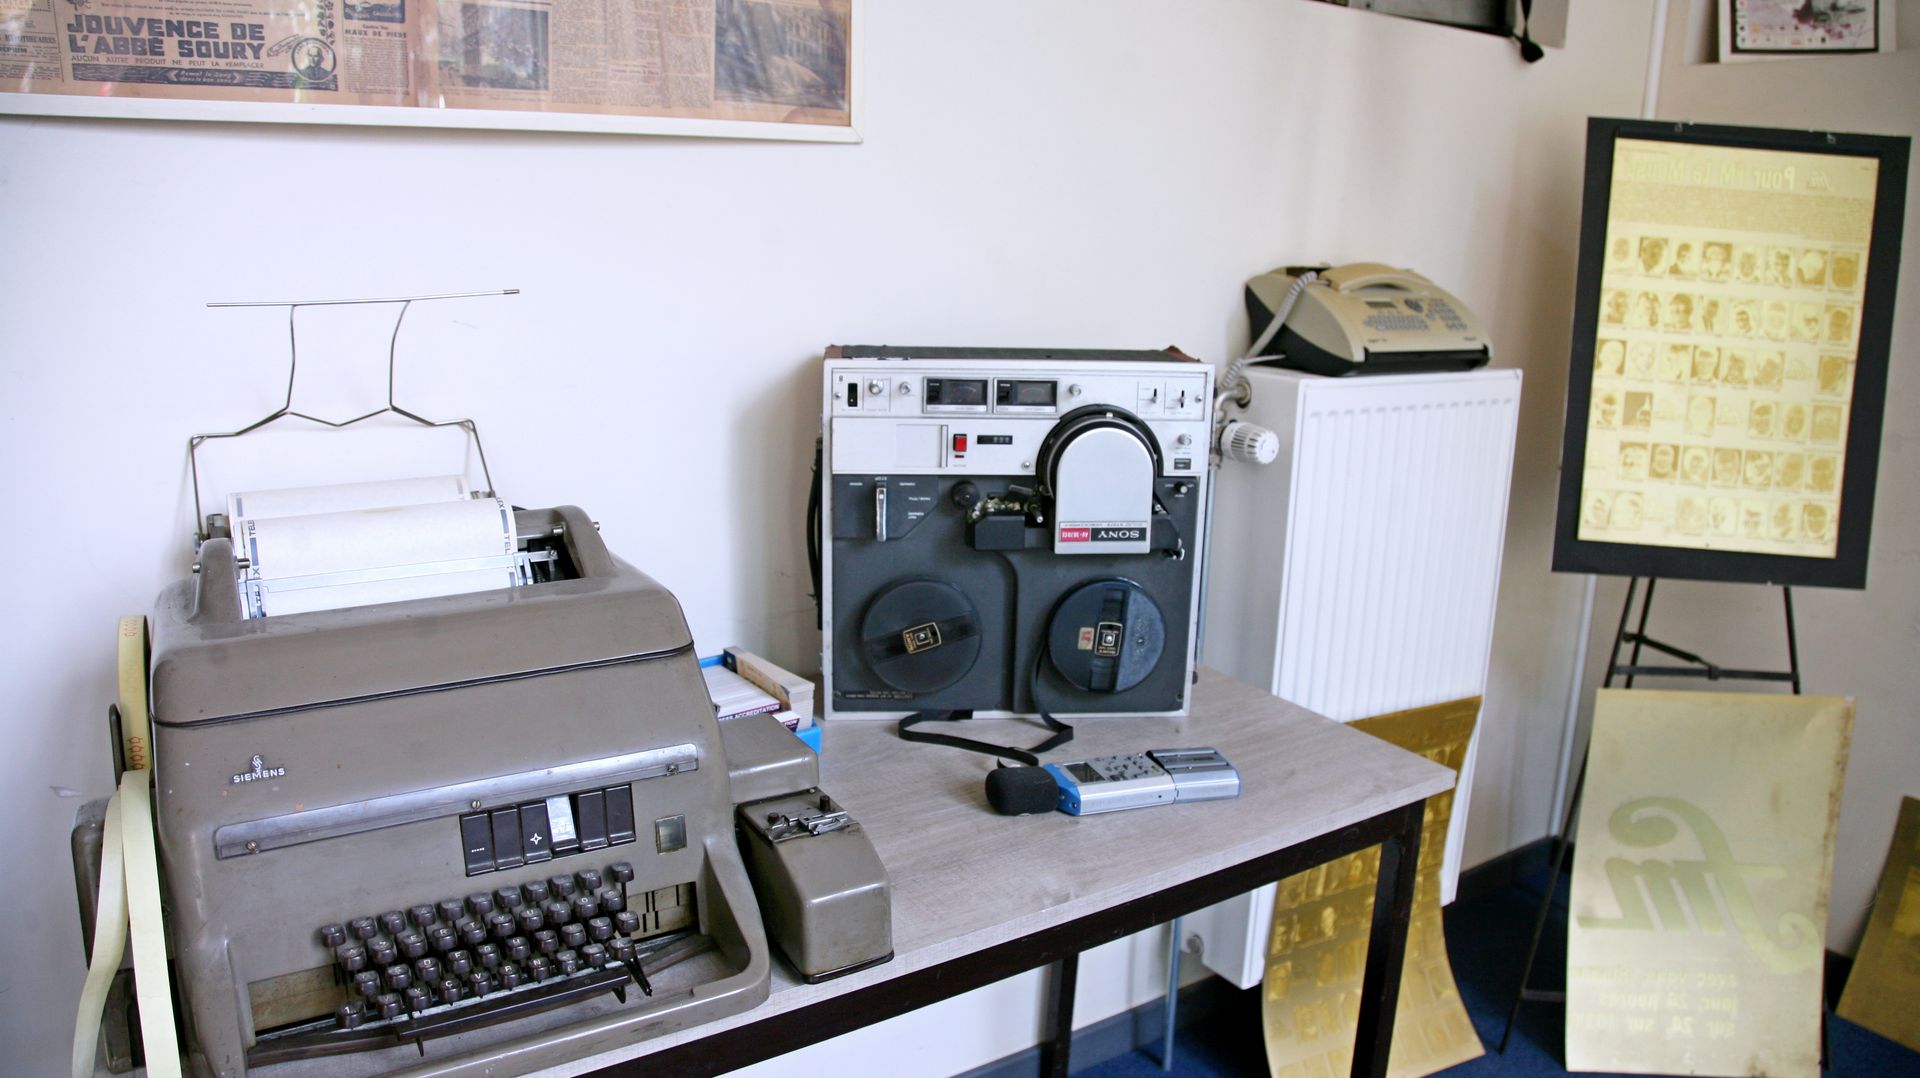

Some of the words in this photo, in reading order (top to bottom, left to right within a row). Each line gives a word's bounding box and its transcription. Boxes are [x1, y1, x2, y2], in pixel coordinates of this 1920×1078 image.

[67, 14, 219, 39] JOUVENCE
[230, 22, 265, 41] DE
[177, 39, 265, 60] SOURY
[71, 55, 100, 63] AUCUN
[135, 57, 167, 65] PRODUIT
[1097, 530, 1140, 539] SONY
[233, 767, 285, 783] SIEMENS
